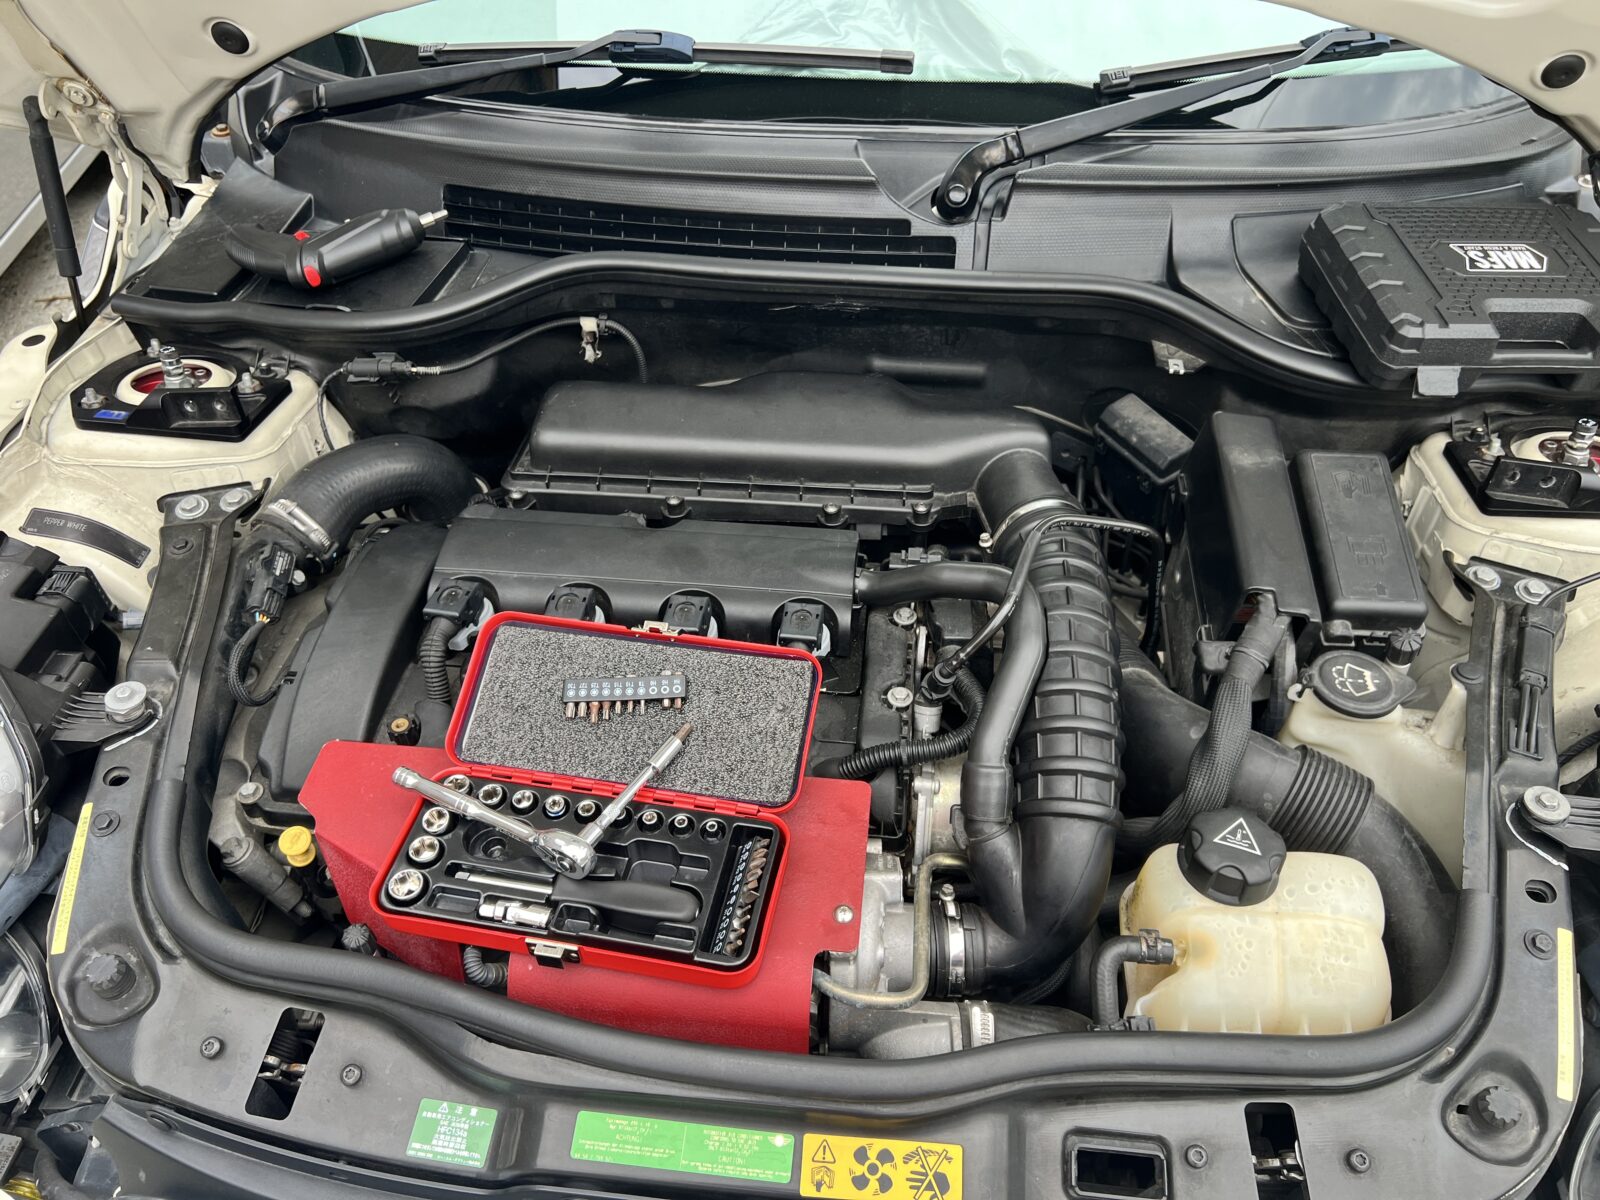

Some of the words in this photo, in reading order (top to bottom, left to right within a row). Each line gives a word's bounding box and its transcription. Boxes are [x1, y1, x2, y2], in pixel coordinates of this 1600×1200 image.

[1466, 250, 1542, 269] MAFS
[43, 516, 65, 527] PEPPER
[66, 520, 87, 531] WHITE
[437, 1125, 468, 1138] HFC134a
